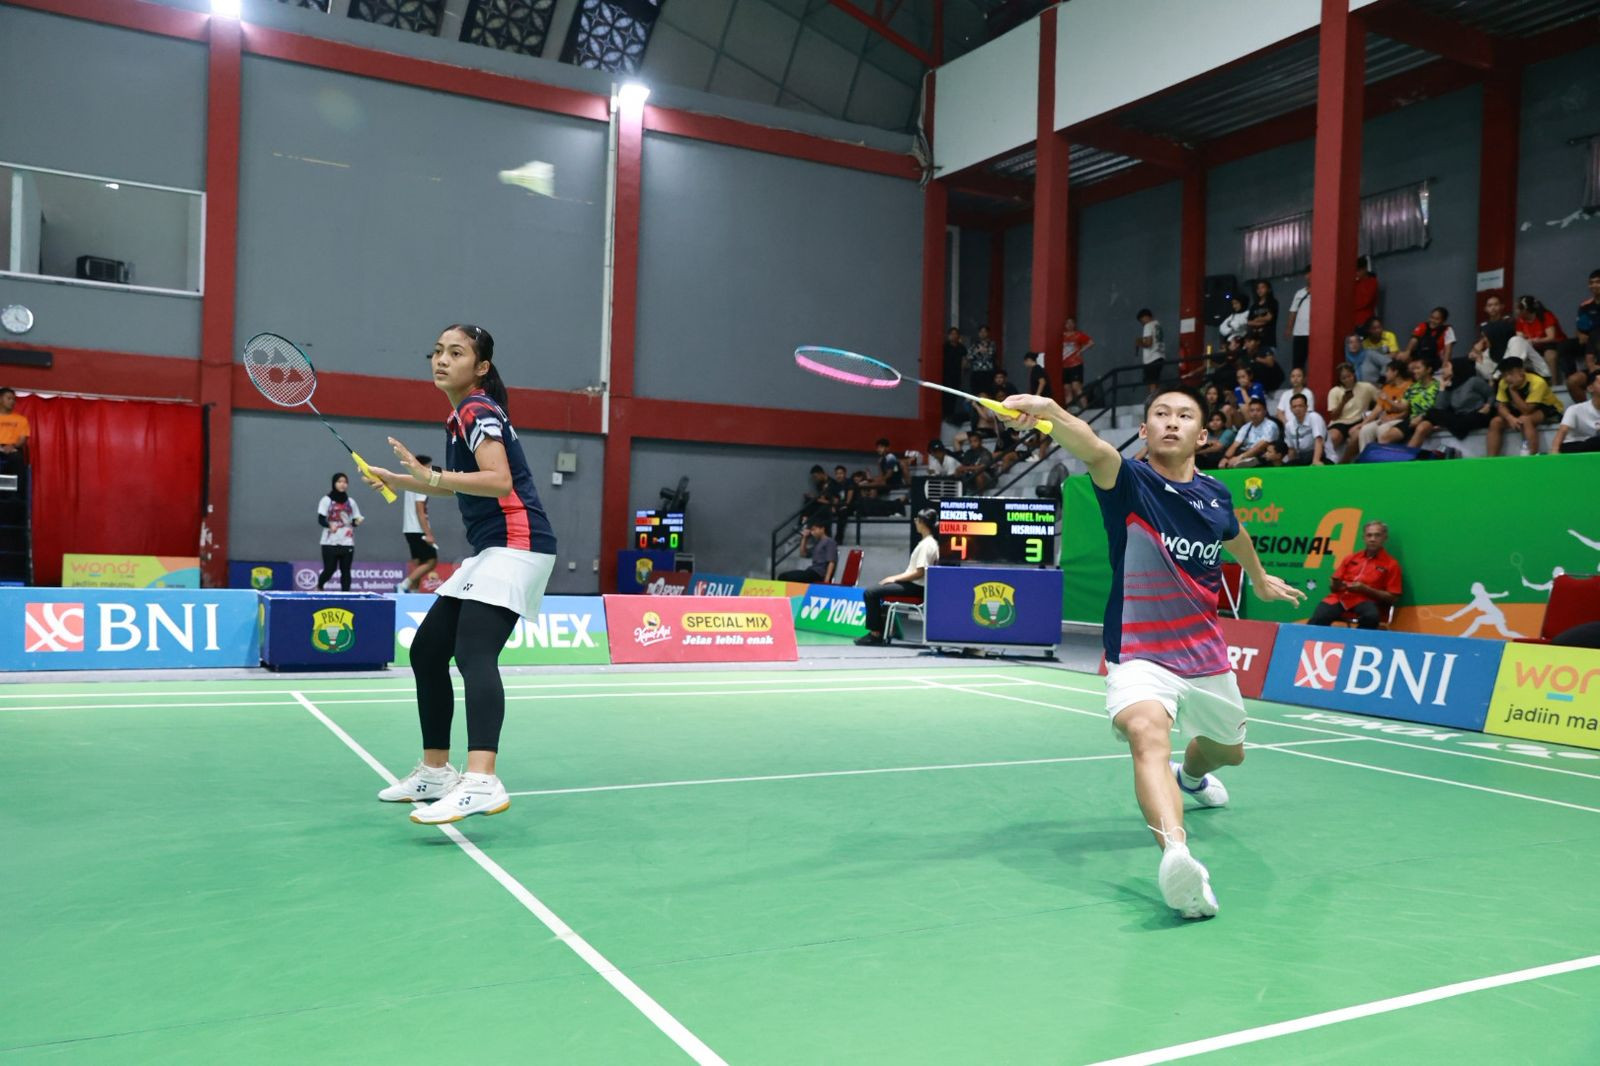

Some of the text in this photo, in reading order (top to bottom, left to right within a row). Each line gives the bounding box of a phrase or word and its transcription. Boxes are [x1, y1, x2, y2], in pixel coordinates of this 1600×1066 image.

[941, 510, 968, 520] KENZIE
[1007, 512, 1055, 523] LIONEL Irvin
[941, 524, 968, 532] LUNA R
[950, 536, 967, 560] 4
[1025, 538, 1043, 563] 3
[1161, 532, 1222, 560] wondr
[71, 559, 140, 574] wondr
[981, 585, 1006, 599] PBSI
[321, 611, 344, 625] PBSI
[827, 598, 867, 627] YONE
[96, 603, 221, 653] BNI
[686, 616, 769, 628] SPECIAL MIX
[682, 635, 712, 645] Jelas
[715, 635, 744, 645] lebih
[1343, 644, 1458, 706] BNI
[1504, 704, 1560, 726] jadiin
